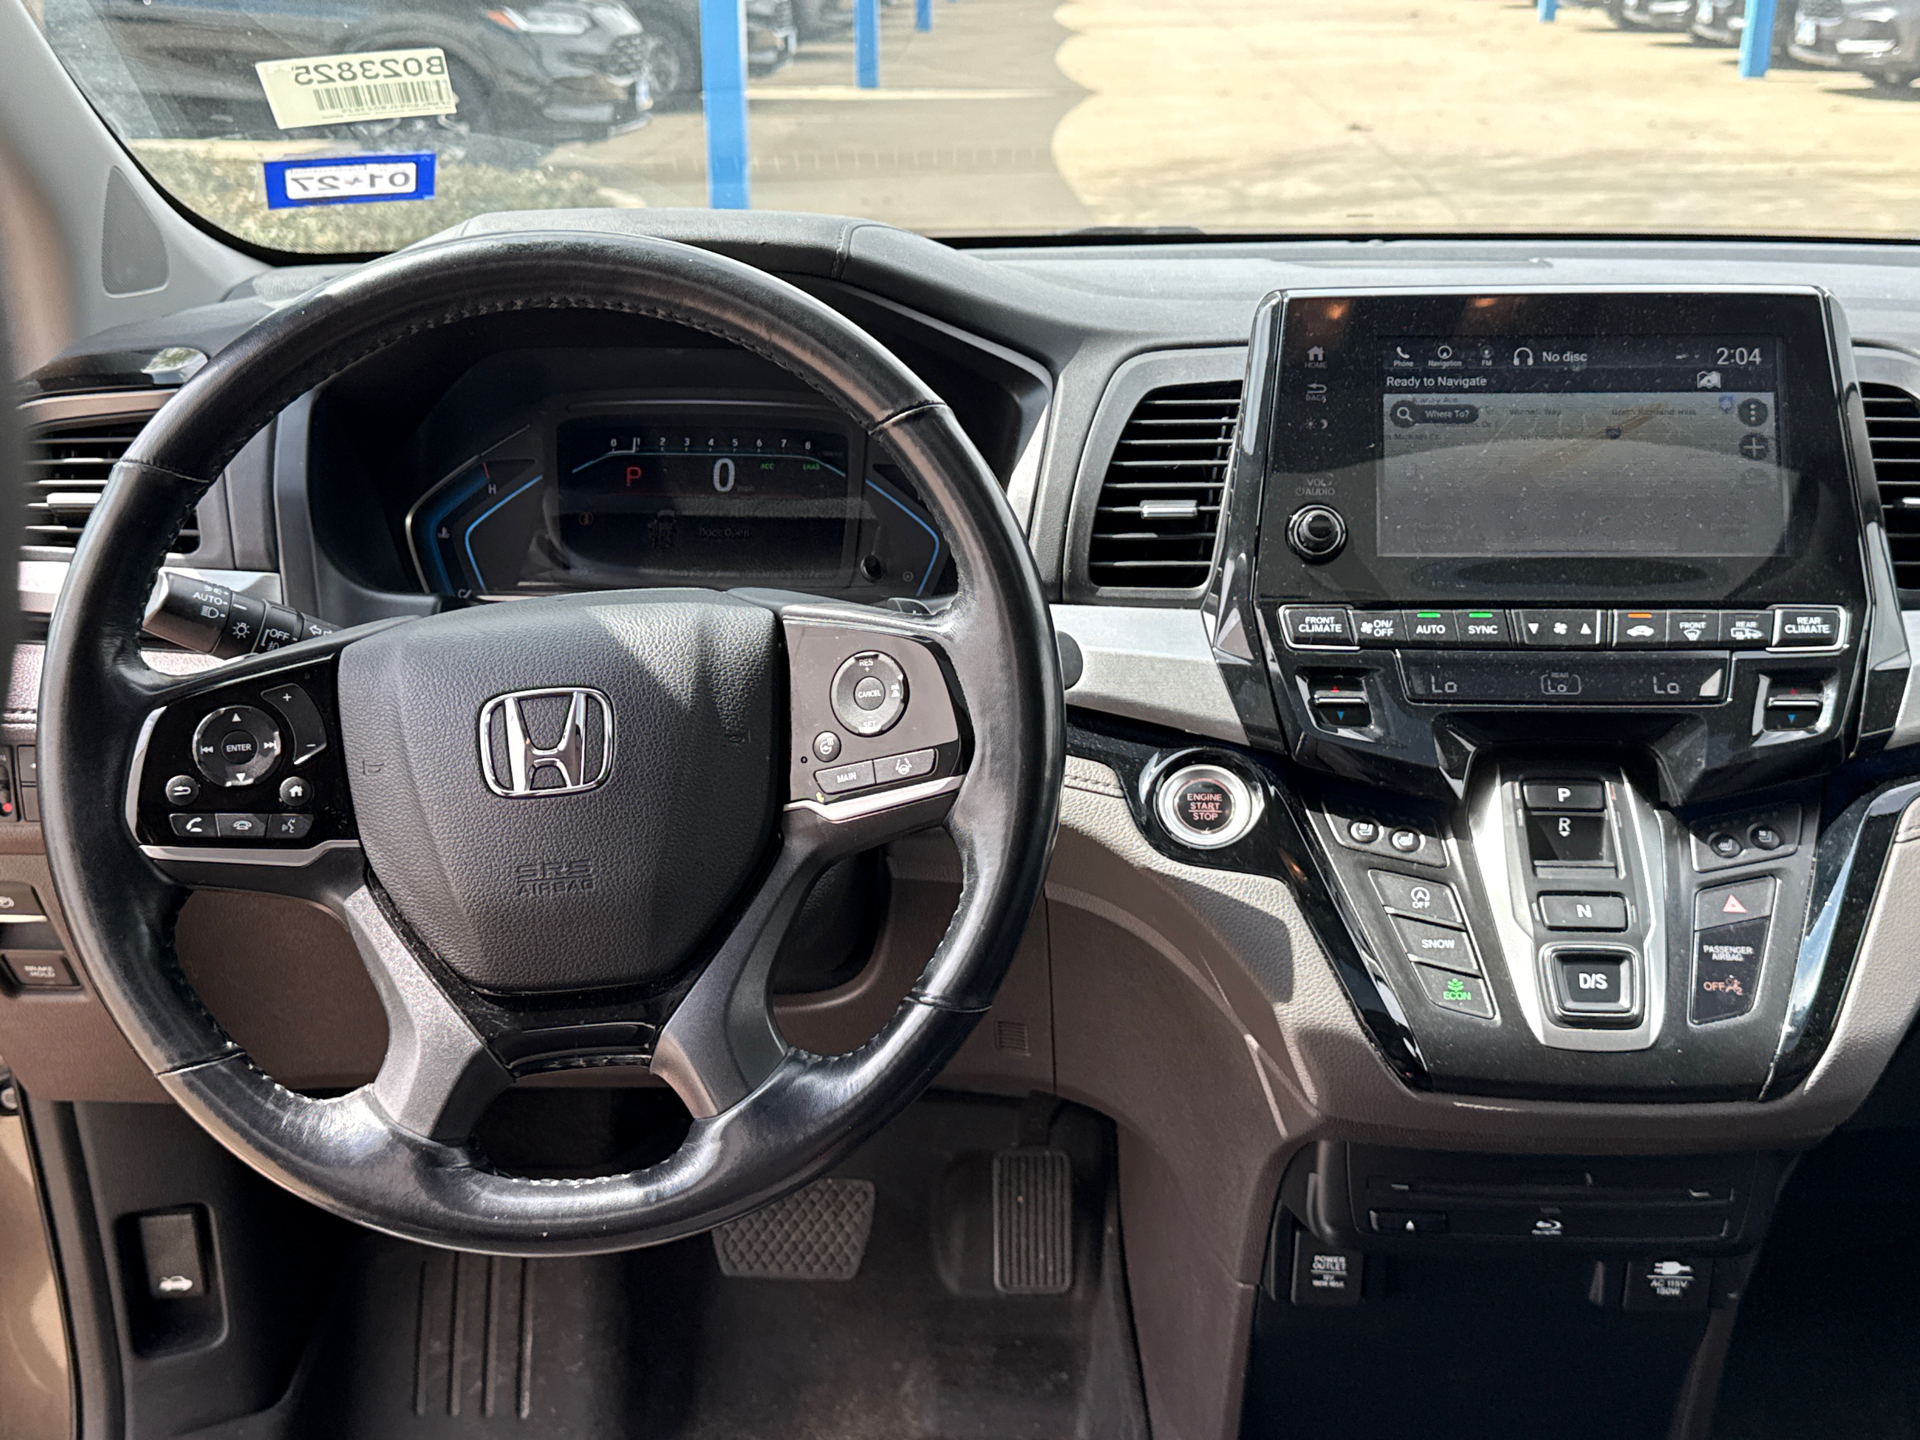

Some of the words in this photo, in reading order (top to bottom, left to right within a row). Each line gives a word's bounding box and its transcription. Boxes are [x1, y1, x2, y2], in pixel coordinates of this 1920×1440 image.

[1542, 352, 1560, 362] No
[1563, 351, 1588, 362] disc
[1716, 347, 1762, 365] 2:04
[1428, 360, 1462, 368] Navigation
[1386, 376, 1420, 388] Ready
[1423, 378, 1434, 386] to
[1438, 376, 1487, 388] Navigate
[1425, 410, 1452, 418] Where
[1454, 410, 1470, 418] To?
[610, 438, 617, 447] 0
[660, 438, 666, 446] 2
[684, 438, 690, 446] 3
[708, 438, 714, 446] 4
[732, 438, 738, 446] 5
[756, 439, 762, 447] 6
[781, 439, 787, 447] 7
[805, 441, 811, 450] 8
[626, 466, 642, 486] P
[712, 458, 735, 492] 0
[488, 484, 496, 494] H
[1306, 487, 1335, 496] AUDIO
[193, 592, 222, 605] AUTO
[1299, 624, 1342, 633] CLIMATE
[1374, 620, 1392, 628] ON/
[269, 628, 290, 640] OFF
[1374, 628, 1394, 637] OFF
[1416, 625, 1445, 634] AUTO
[1468, 625, 1498, 634] SYNC
[1785, 625, 1830, 634] CLIMATE
[859, 659, 874, 667] RES
[226, 744, 252, 752] ENTER
[837, 772, 856, 783] MAIN
[1558, 788, 1571, 802] P
[1190, 802, 1220, 810] START
[1559, 818, 1571, 831] R
[1576, 905, 1592, 917] N
[1422, 939, 1454, 948] SNOW
[1703, 945, 1753, 954] PASSENGER
[1579, 973, 1608, 991] D/S
[1703, 981, 1725, 991] OFF
[1443, 992, 1471, 1000] ECON
